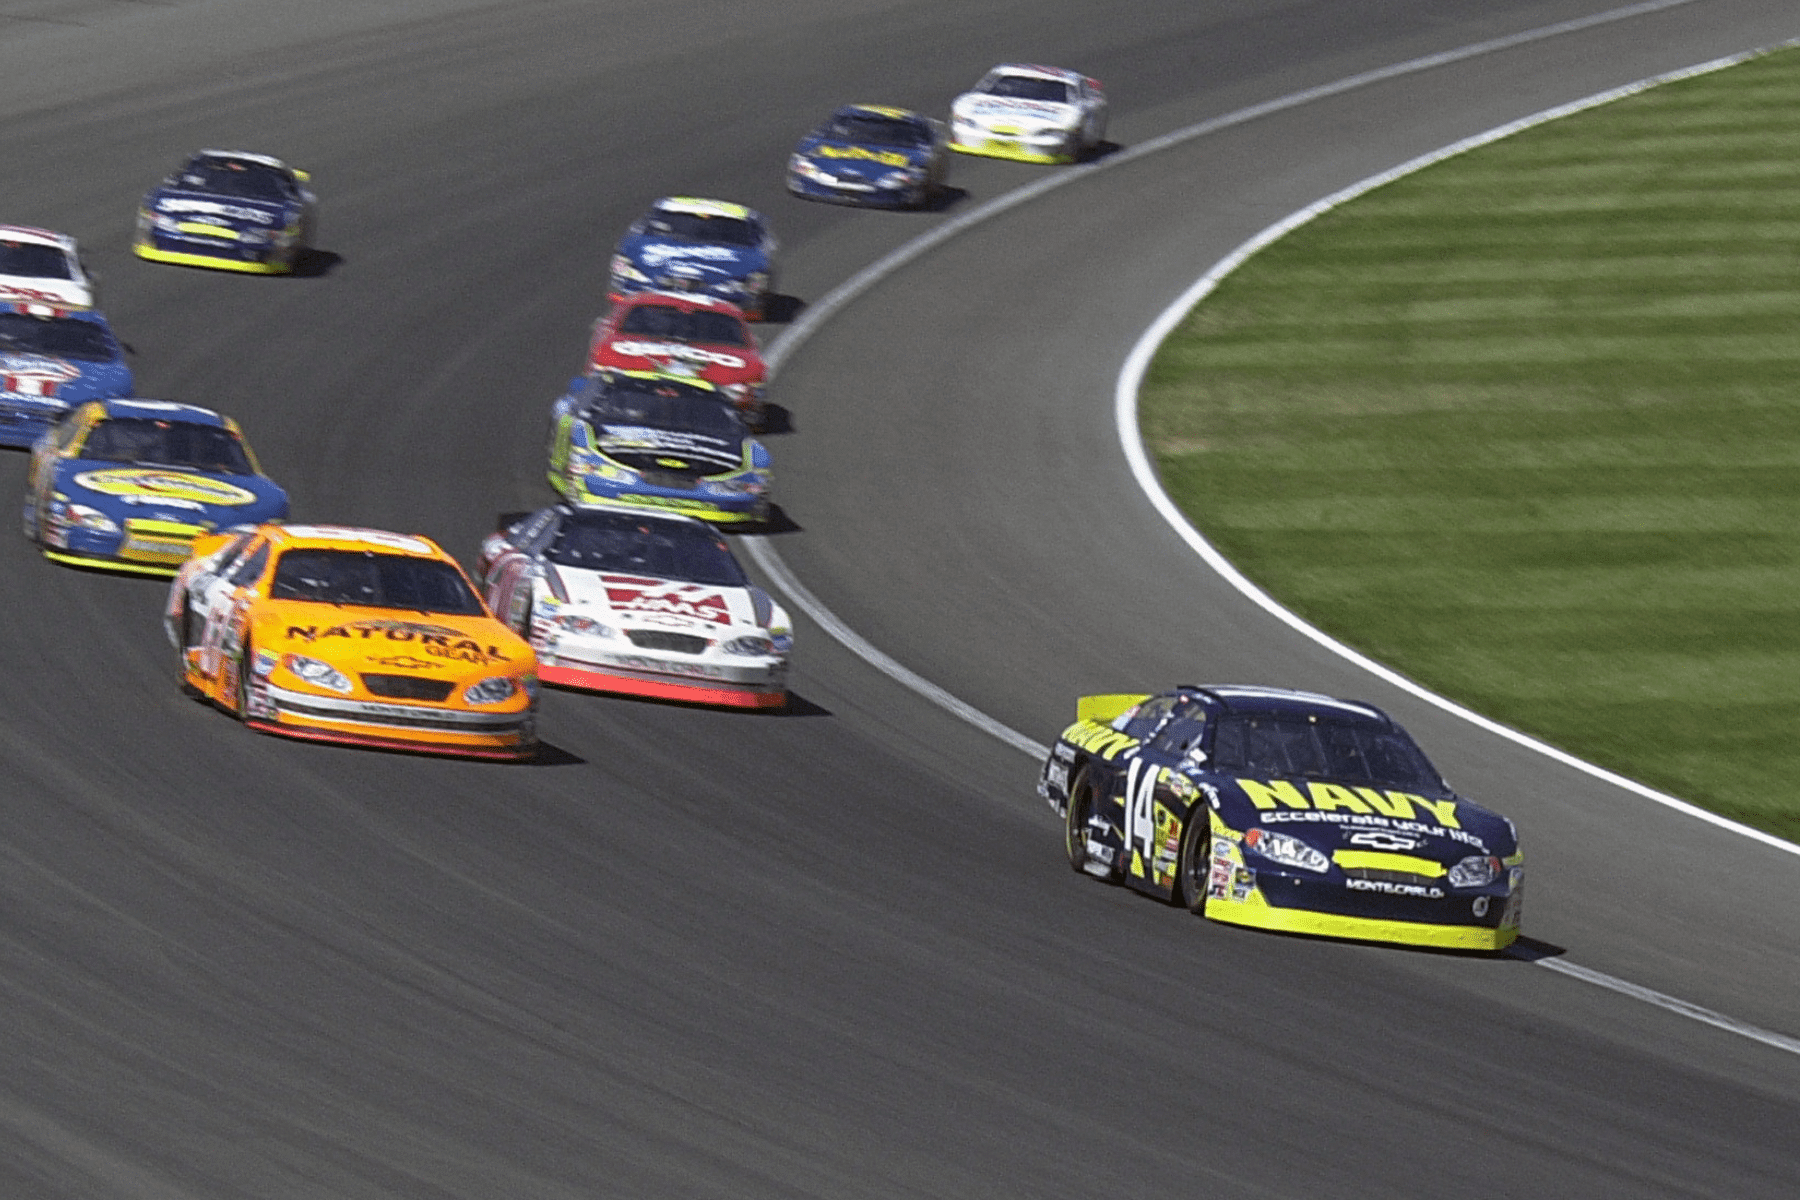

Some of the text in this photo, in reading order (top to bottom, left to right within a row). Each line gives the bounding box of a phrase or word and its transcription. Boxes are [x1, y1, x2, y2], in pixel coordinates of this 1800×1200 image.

[285, 625, 511, 662] NATURAL
[1125, 757, 1160, 859] 14
[1235, 779, 1461, 829] NAVY
